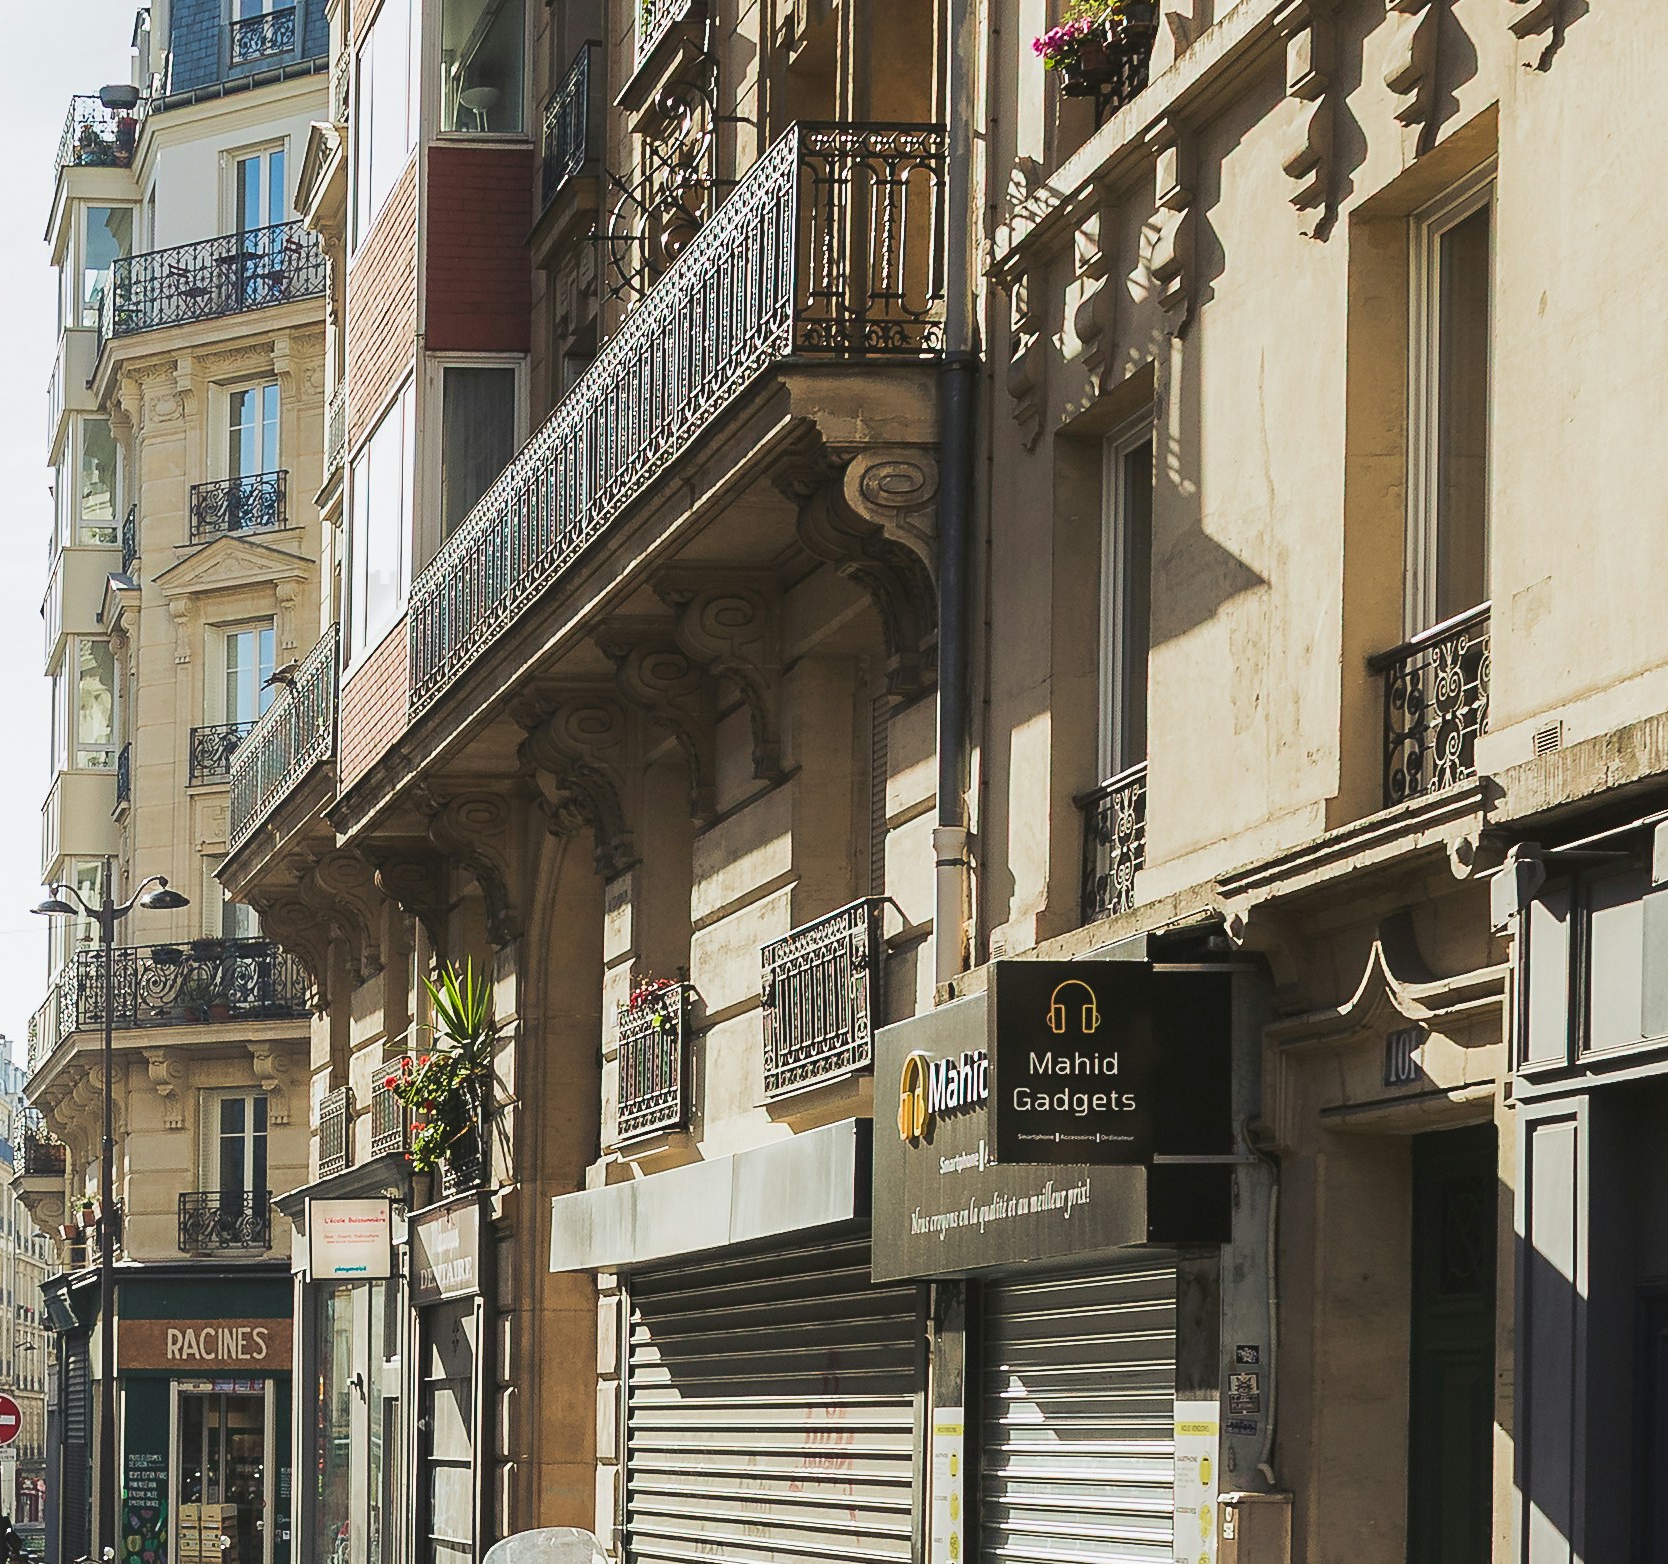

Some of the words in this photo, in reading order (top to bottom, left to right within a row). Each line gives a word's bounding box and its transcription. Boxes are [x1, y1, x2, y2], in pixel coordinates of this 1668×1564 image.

[1029, 1052, 1119, 1076] Mahid
[1013, 1087, 1137, 1117] Gadgets
[1017, 1133, 1055, 1143] Smartphone
[1060, 1133, 1096, 1142] Accessoires
[1100, 1133, 1135, 1142] Ordinateur
[939, 1151, 980, 1175] Smartphone
[911, 1206, 930, 1235] Nous
[930, 1211, 958, 1241] croyons
[958, 1209, 969, 1227] en
[969, 1197, 978, 1225] la
[979, 1191, 1007, 1234] qualité
[1007, 1195, 1018, 1218] et
[1017, 1198, 1029, 1215] au
[1029, 1180, 1067, 1213] meilleur
[166, 1327, 269, 1361] RACINES
